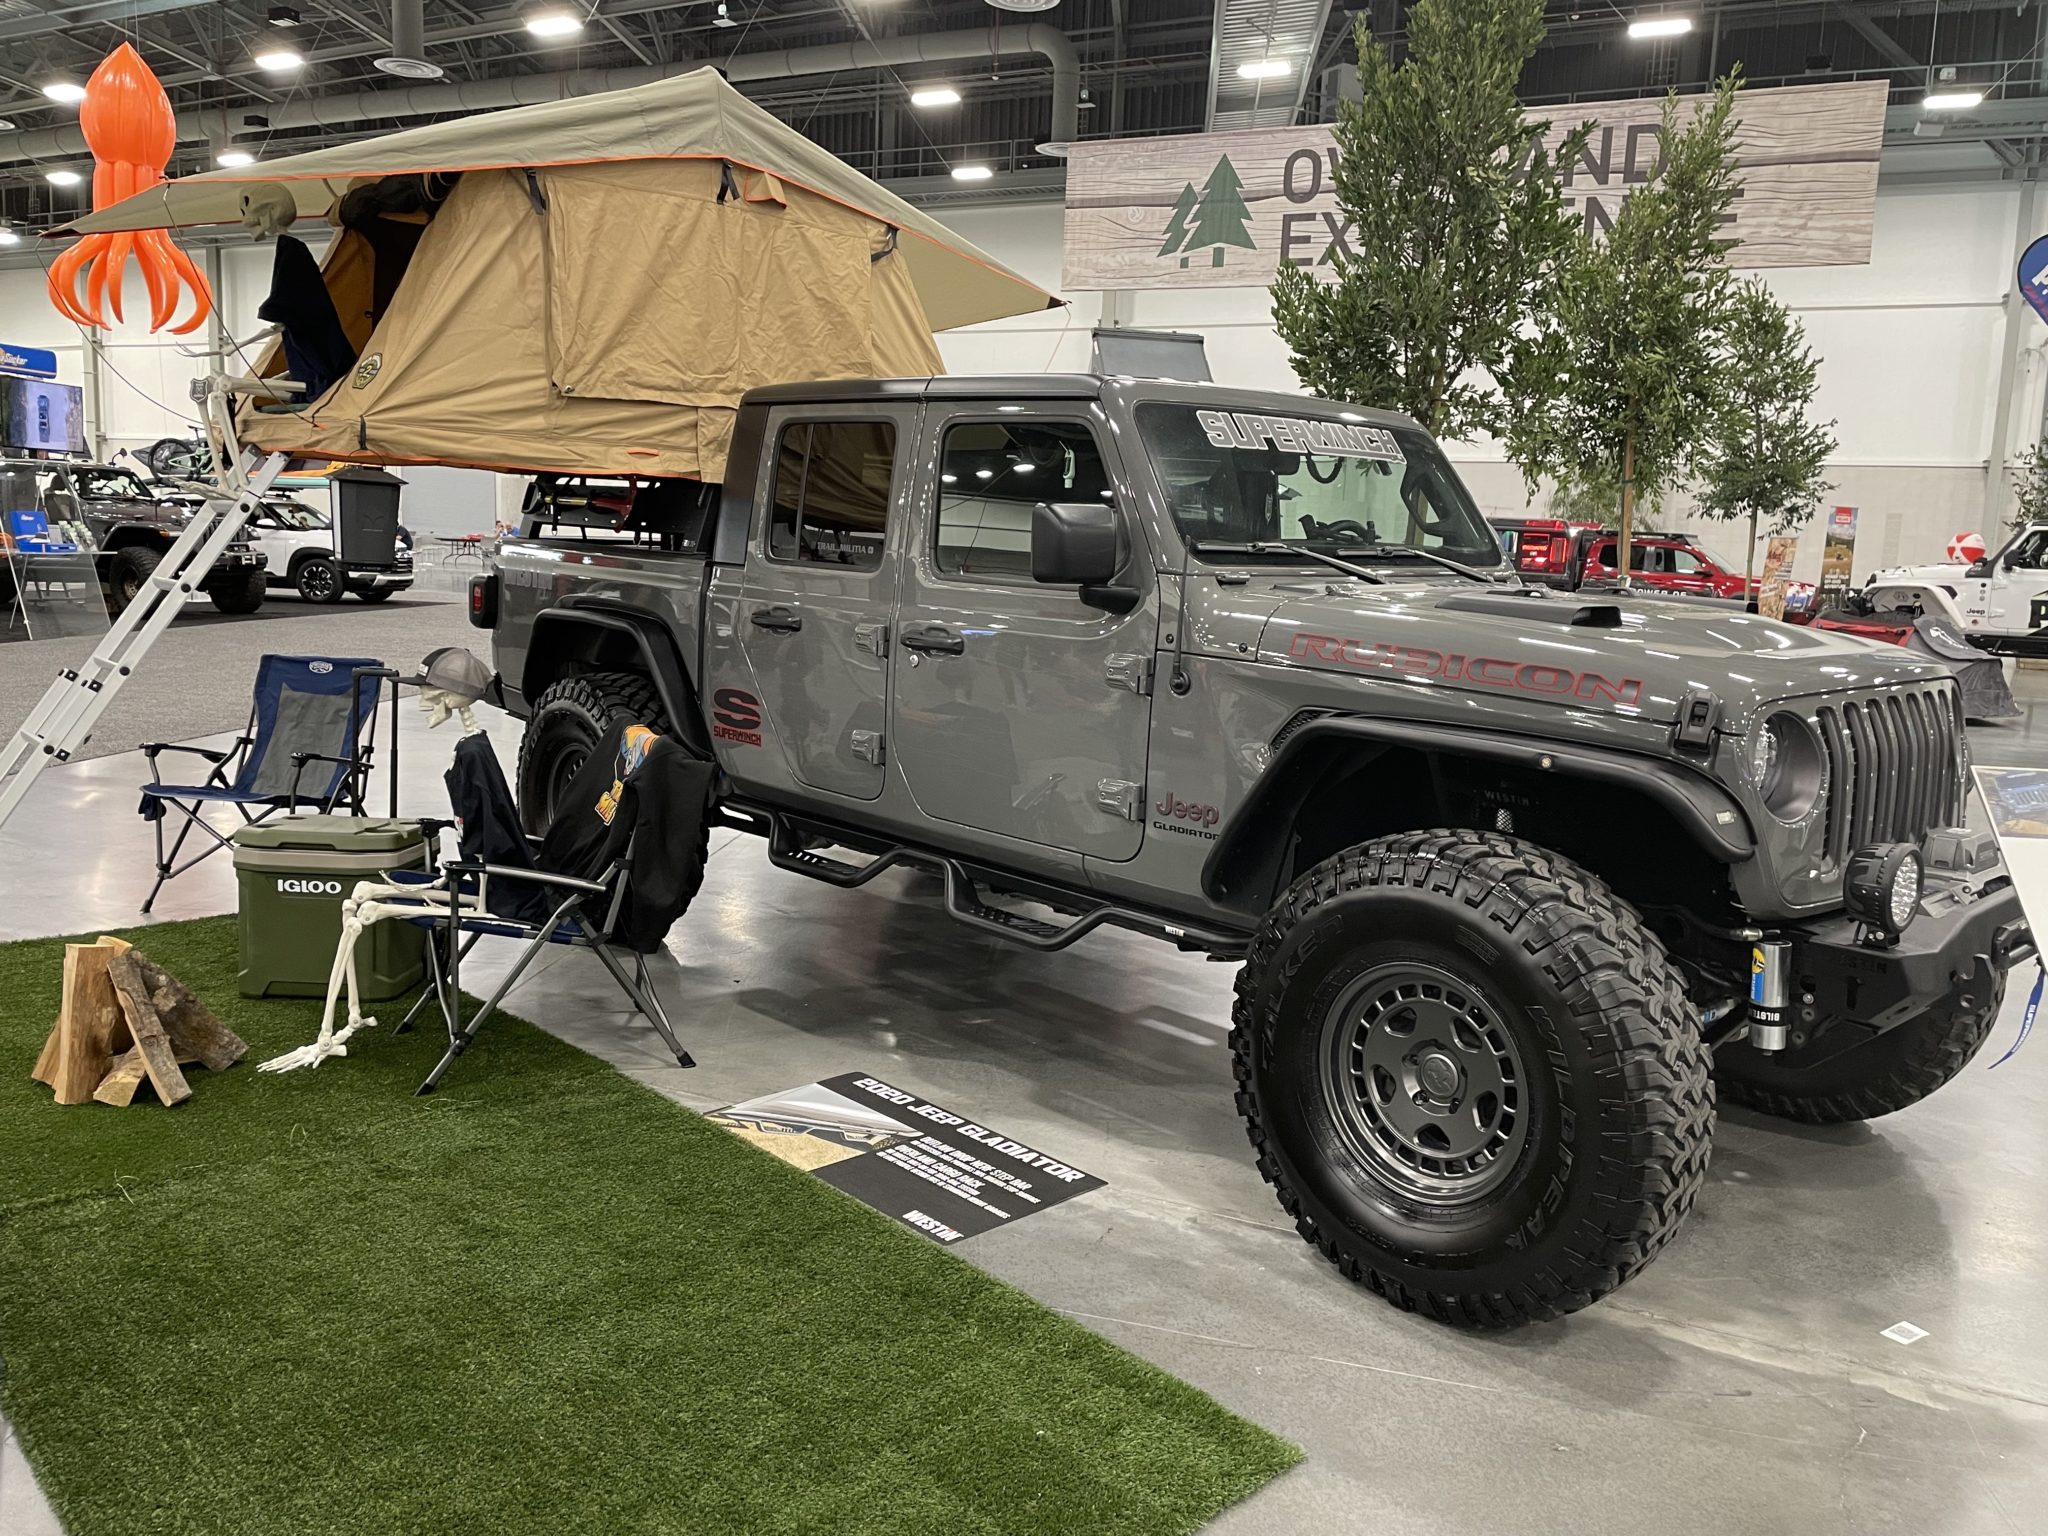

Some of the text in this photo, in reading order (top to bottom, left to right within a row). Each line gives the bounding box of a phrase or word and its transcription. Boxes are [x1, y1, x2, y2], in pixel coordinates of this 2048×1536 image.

[1284, 124, 1671, 204] OAND
[1196, 410, 1407, 464] SUPERWINCH
[1966, 608, 1986, 616] Jeep
[1289, 632, 1644, 706] RUBICON
[713, 725, 762, 748] SUPERWINCH
[1156, 791, 1219, 828] Jeep
[277, 879, 342, 894] IGLOO
[852, 1078, 915, 1105] 2020
[909, 1103, 964, 1127] JEEP
[956, 1124, 1086, 1183] GLADIATOR
